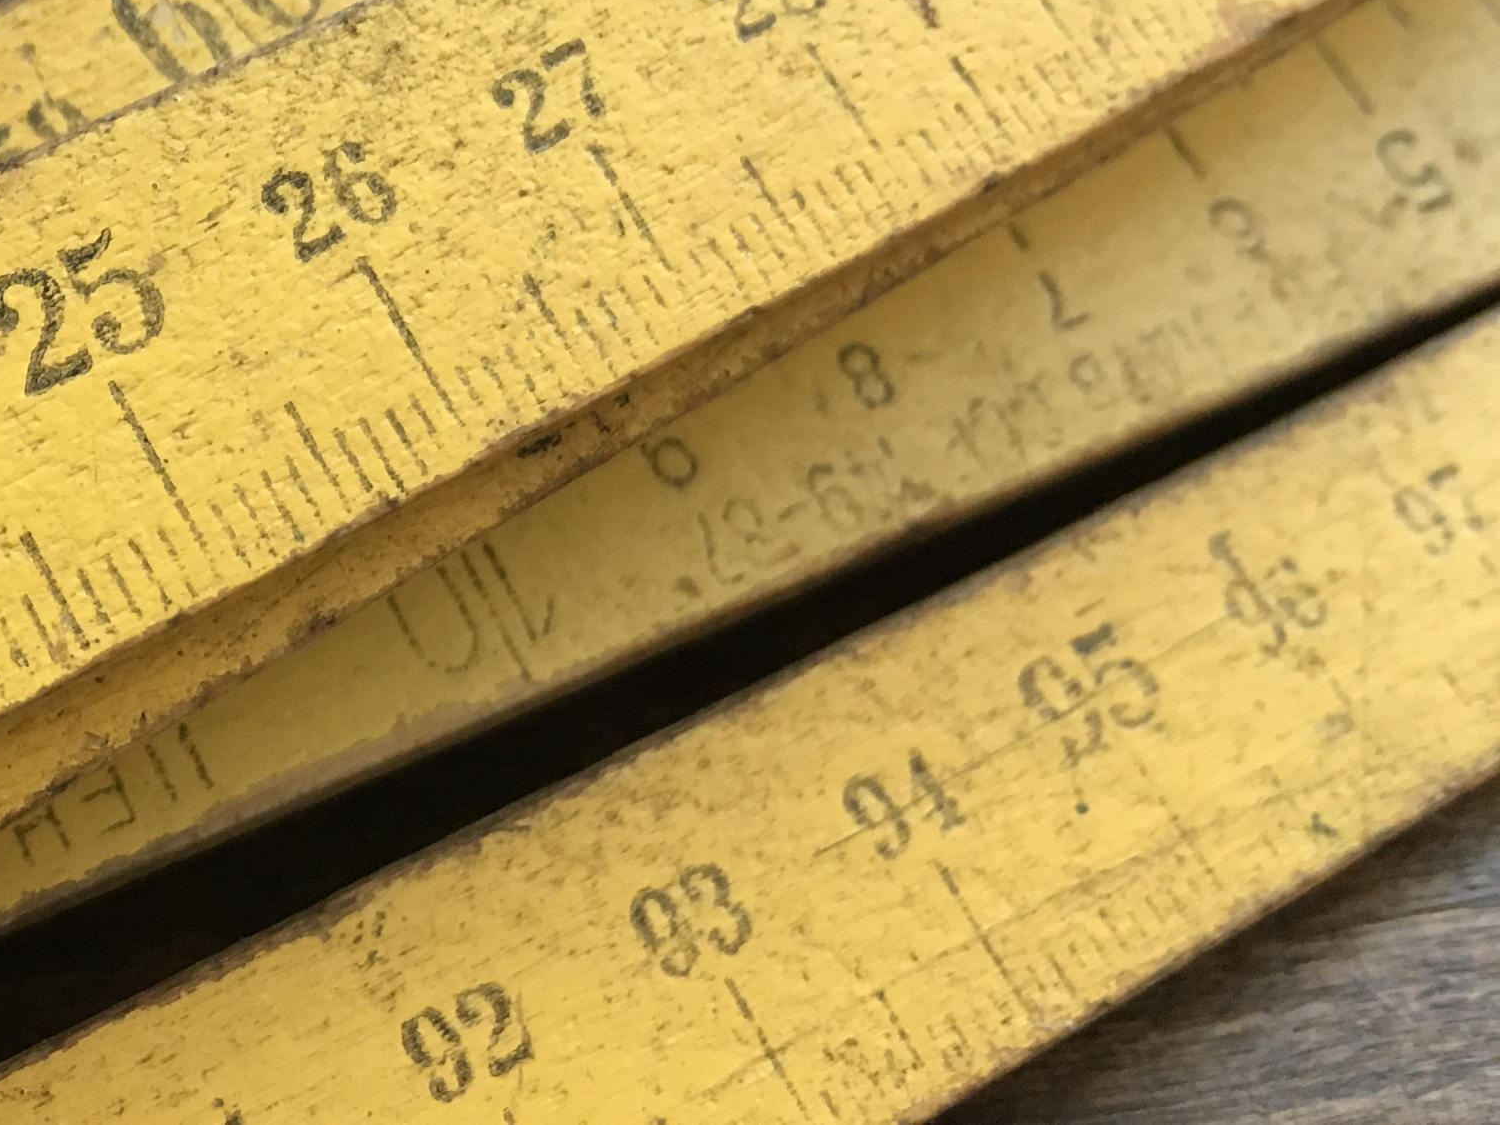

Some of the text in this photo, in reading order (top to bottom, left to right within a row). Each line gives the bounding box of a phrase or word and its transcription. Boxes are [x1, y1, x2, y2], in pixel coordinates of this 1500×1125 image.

[493, 39, 606, 155] 27
[261, 141, 397, 263] 26
[1375, 127, 1453, 215] 5
[1037, 270, 1090, 332] 7
[836, 340, 897, 409] 8
[1017, 622, 1162, 760] 95
[841, 750, 968, 863] 94
[630, 862, 754, 980] 93
[400, 981, 534, 1103] 92
